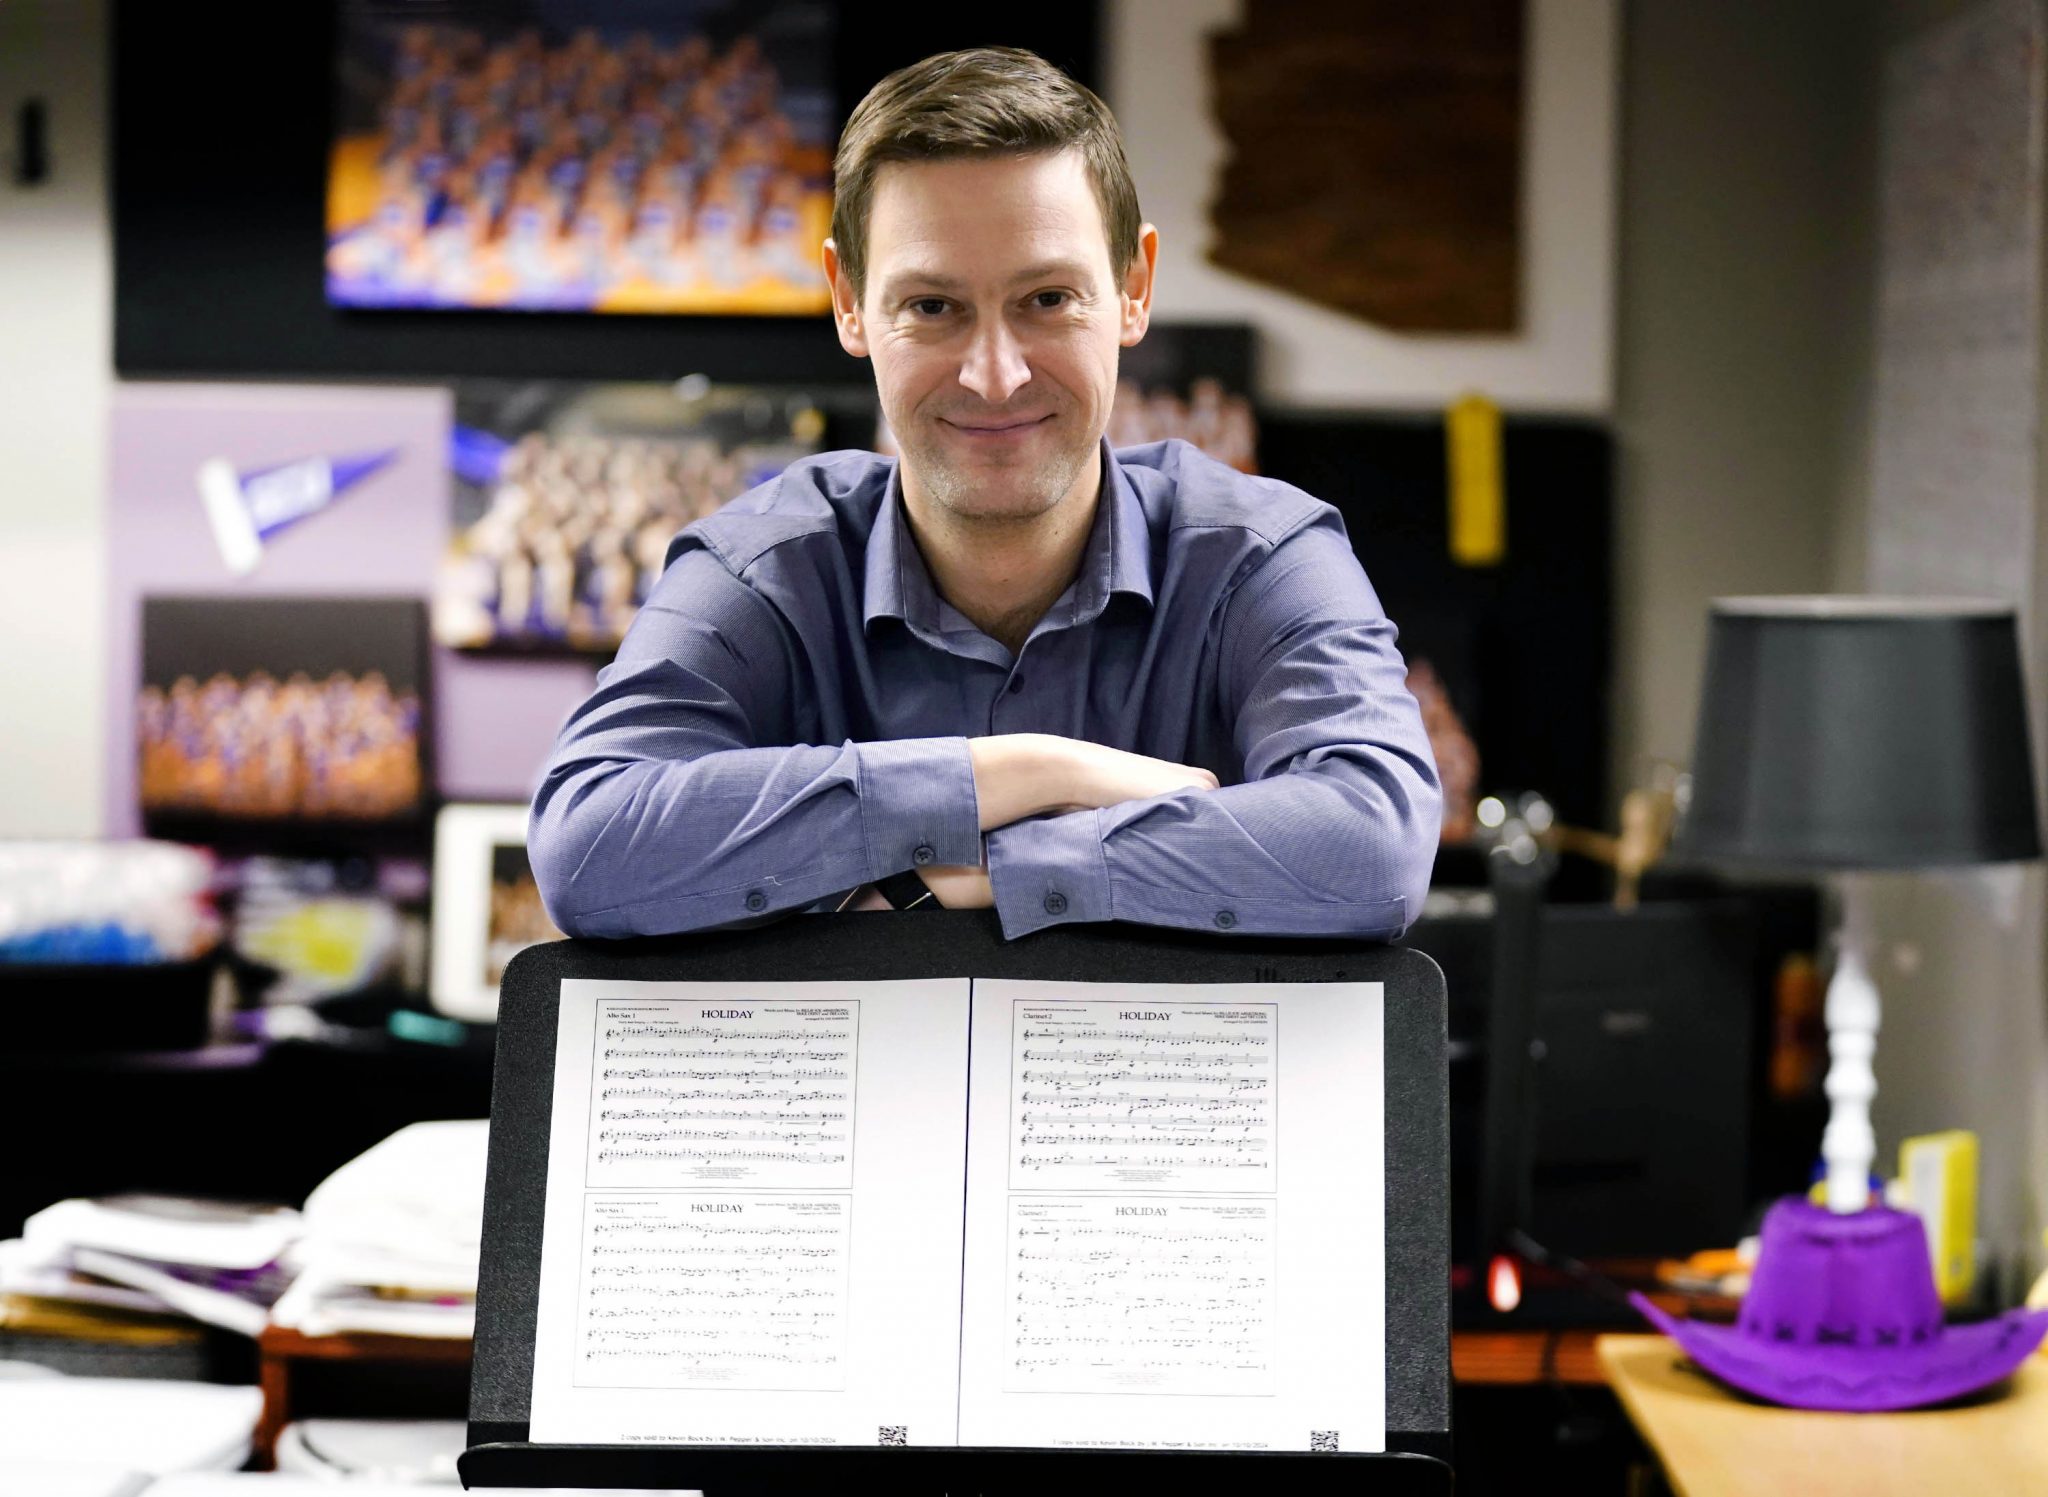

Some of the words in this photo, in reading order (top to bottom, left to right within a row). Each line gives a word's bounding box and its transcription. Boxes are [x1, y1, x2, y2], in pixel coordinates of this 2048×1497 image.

[701, 1009, 754, 1019] HOLIDAY
[1119, 1011, 1172, 1021] HOLIDAY
[691, 1203, 743, 1214] HOLIDAY
[1115, 1206, 1168, 1217] HOLIDAY
